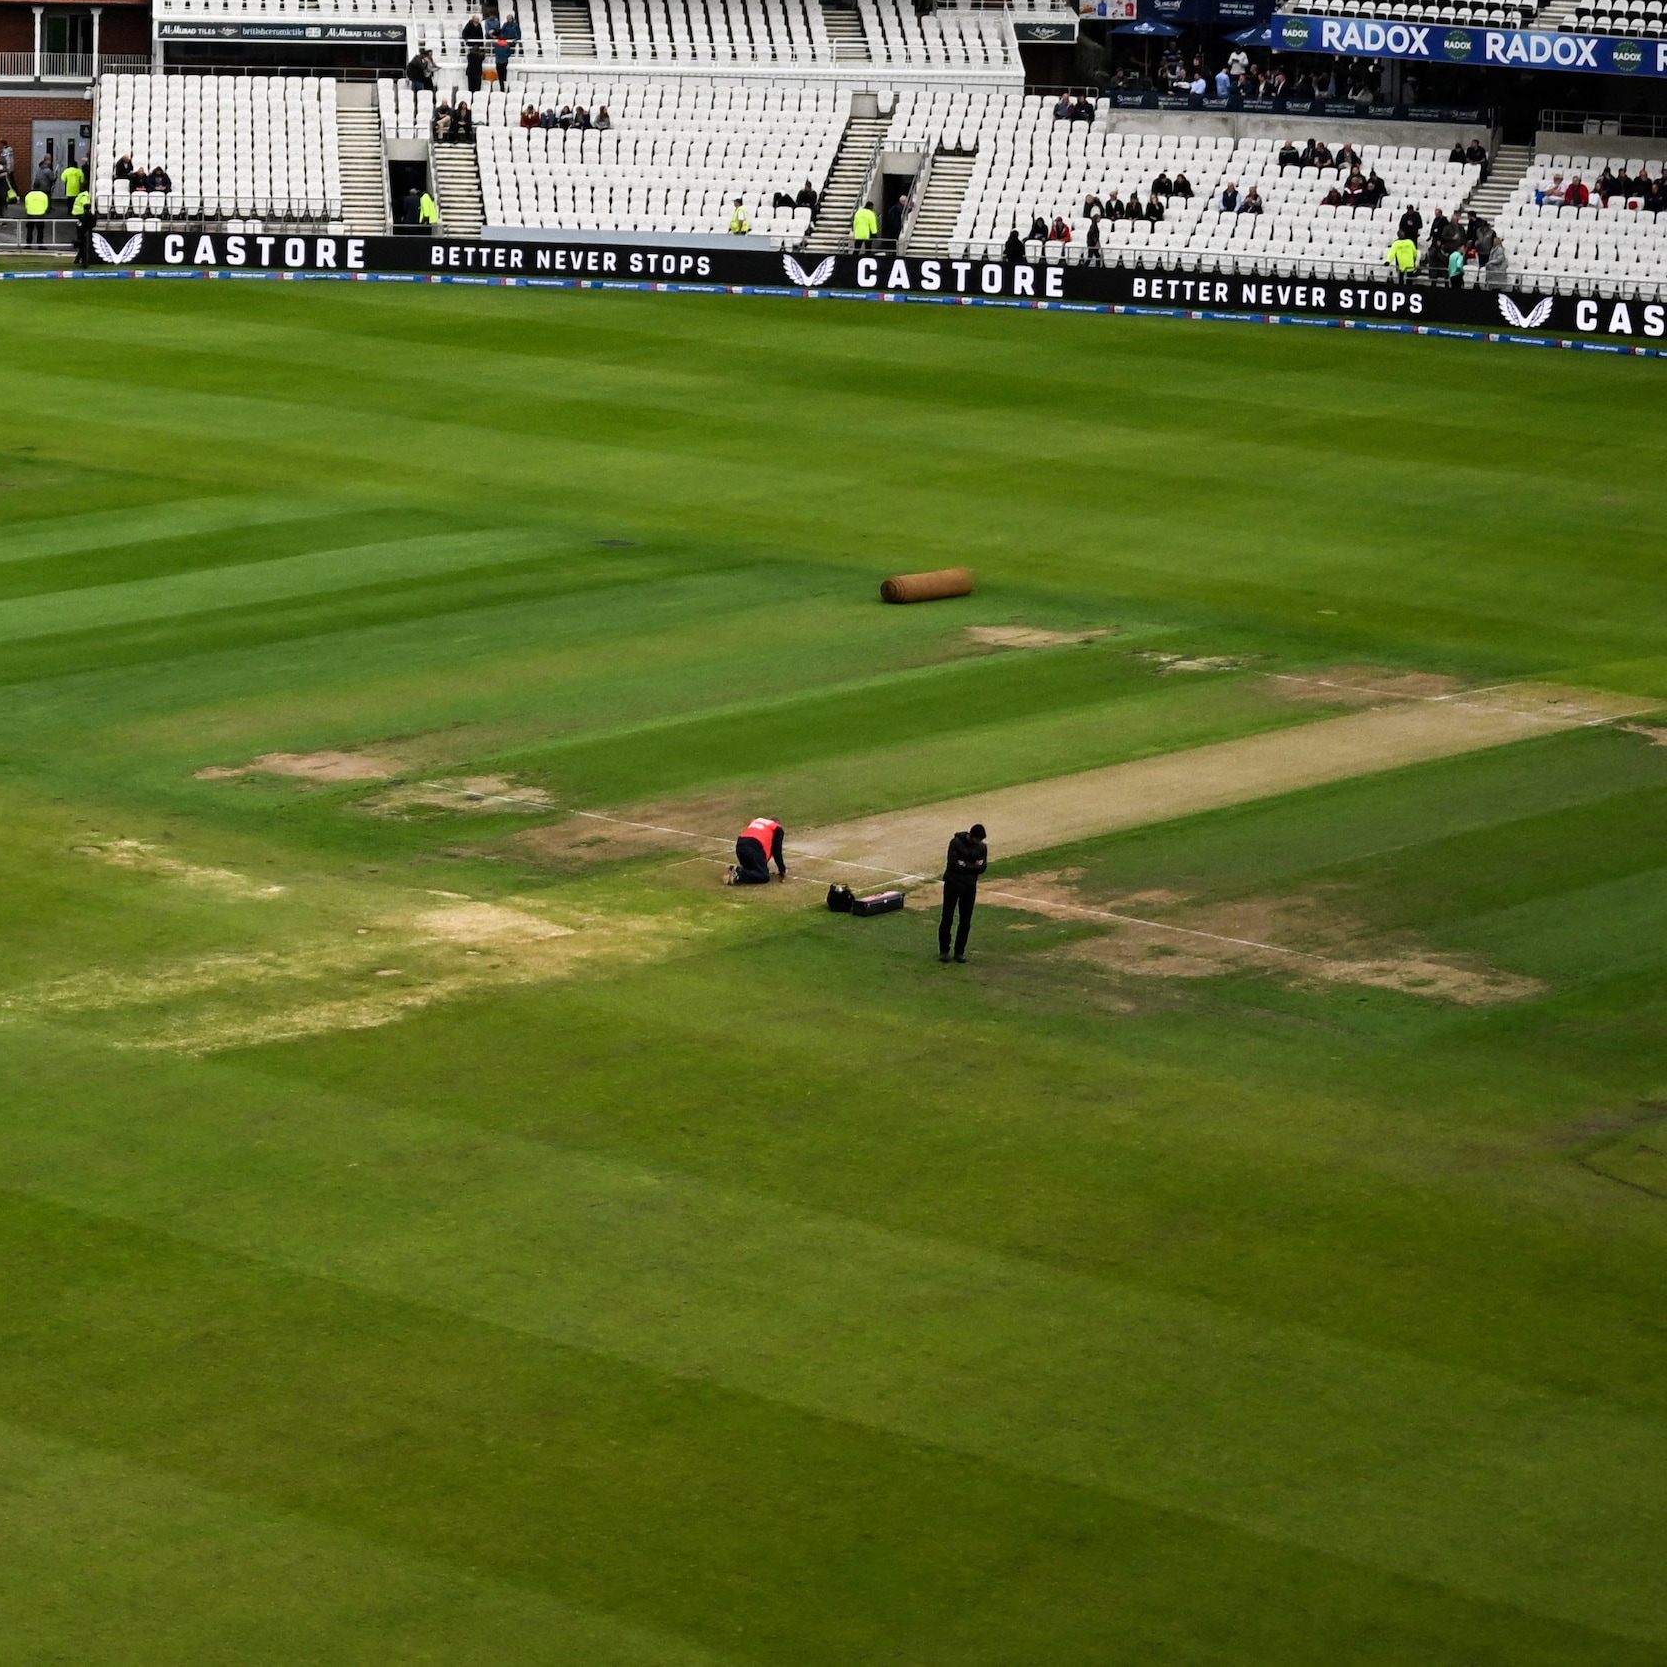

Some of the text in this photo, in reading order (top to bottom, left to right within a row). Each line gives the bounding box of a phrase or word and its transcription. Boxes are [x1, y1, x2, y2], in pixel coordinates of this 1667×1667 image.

[1282, 28, 1309, 39] RADOX
[1322, 20, 1429, 56] RADOX
[1444, 40, 1471, 51] RADOX
[1485, 32, 1598, 67] RADOX
[1613, 50, 1641, 62] RADOX
[164, 235, 365, 268] CASTORE
[431, 246, 711, 276] BETTER NEVER STOPS
[856, 258, 1064, 298] CASTORE
[1132, 277, 1424, 314] BETTER NEVER STOPS
[1576, 300, 1665, 336] CAS
